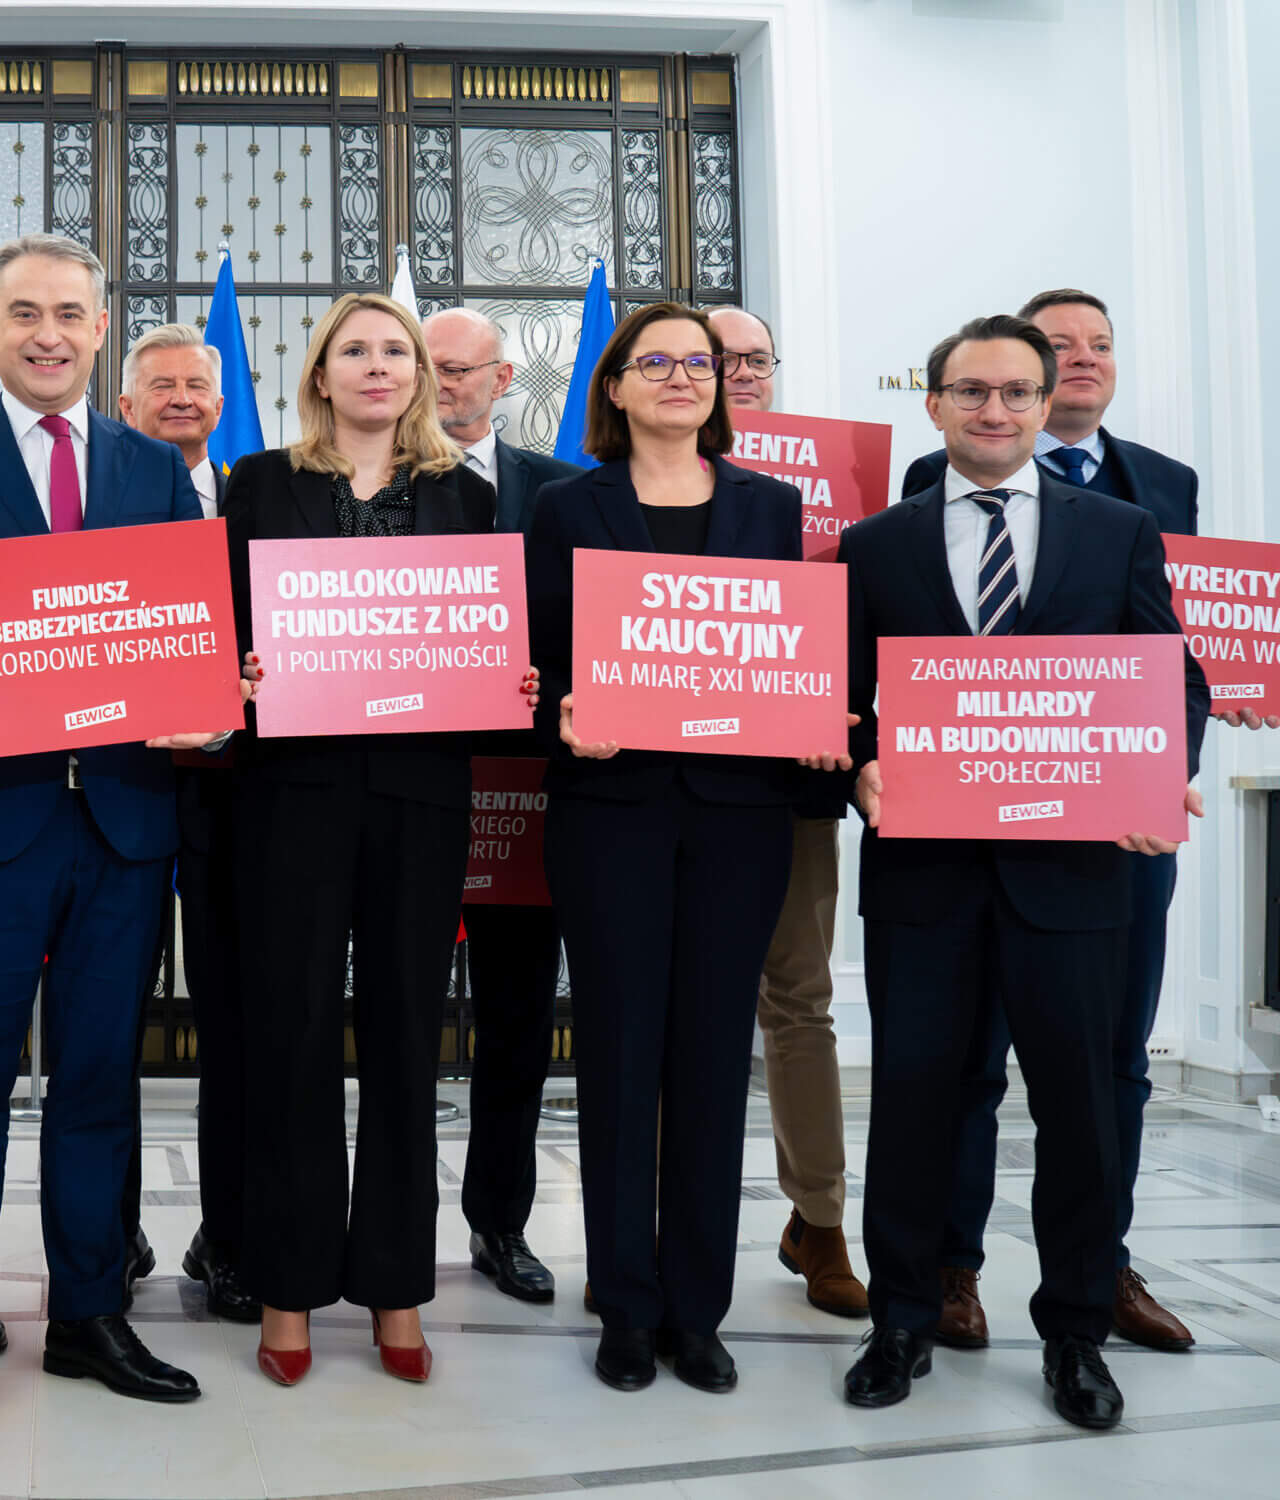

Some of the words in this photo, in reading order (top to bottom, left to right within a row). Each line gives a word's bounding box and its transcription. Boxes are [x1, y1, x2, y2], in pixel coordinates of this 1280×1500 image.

[723, 430, 819, 467] RENTA
[32, 580, 129, 610] FUNDUSZ
[277, 566, 499, 600] ODBLOKOWANE
[641, 572, 782, 615] SYSTEM
[271, 606, 419, 639] FUNDUSZE
[425, 607, 442, 633] Z
[448, 603, 509, 634] KPO
[104, 632, 217, 664] WSPARCIE!
[621, 616, 804, 665] KAUCYJNY
[1184, 634, 1246, 662] OWA
[277, 653, 282, 673] I
[290, 649, 382, 673] POLITYKI
[389, 640, 508, 672] SPÓJNOŚCI!
[910, 657, 1143, 681] ZAGWARANTOWANE
[592, 660, 623, 685] NA
[631, 663, 702, 696] MIARĘ
[708, 667, 743, 692] XXI
[751, 669, 832, 697] WIEKU!
[1213, 685, 1261, 698] LEWICA
[69, 705, 123, 727] LEWICA
[370, 697, 420, 714] LEWICA
[956, 691, 1096, 717] MILIARDY
[685, 720, 736, 735] LEWICA
[895, 726, 936, 752] NA
[941, 725, 1167, 754] BUDOWNICTWO
[959, 760, 1102, 784] SPOŁECZNE!
[1003, 802, 1060, 820] LEWICA
[468, 840, 510, 860] RTU
